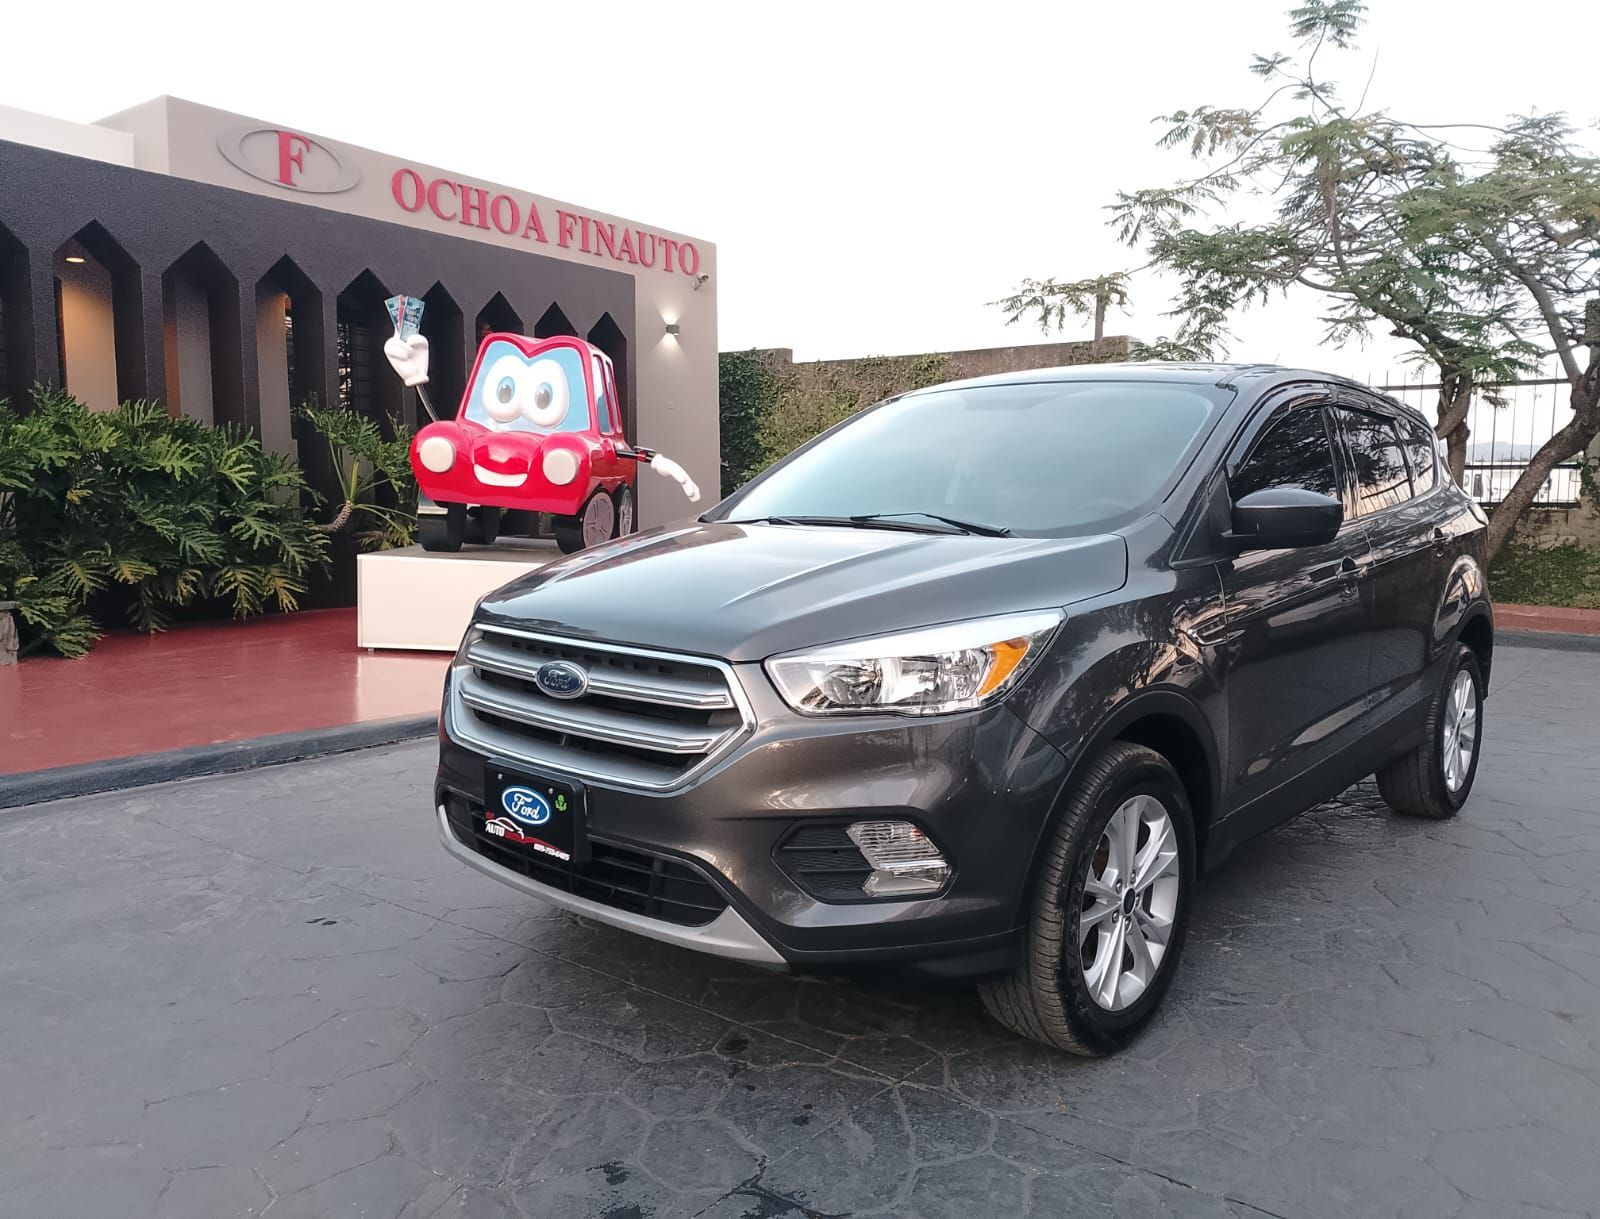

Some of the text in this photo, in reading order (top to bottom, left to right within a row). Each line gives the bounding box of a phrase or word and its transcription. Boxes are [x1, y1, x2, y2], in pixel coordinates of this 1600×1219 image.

[276, 130, 311, 187] F
[391, 168, 700, 276] OCHOA FINAUTO
[511, 793, 541, 820] Ford
[485, 822, 505, 837] AUTO
